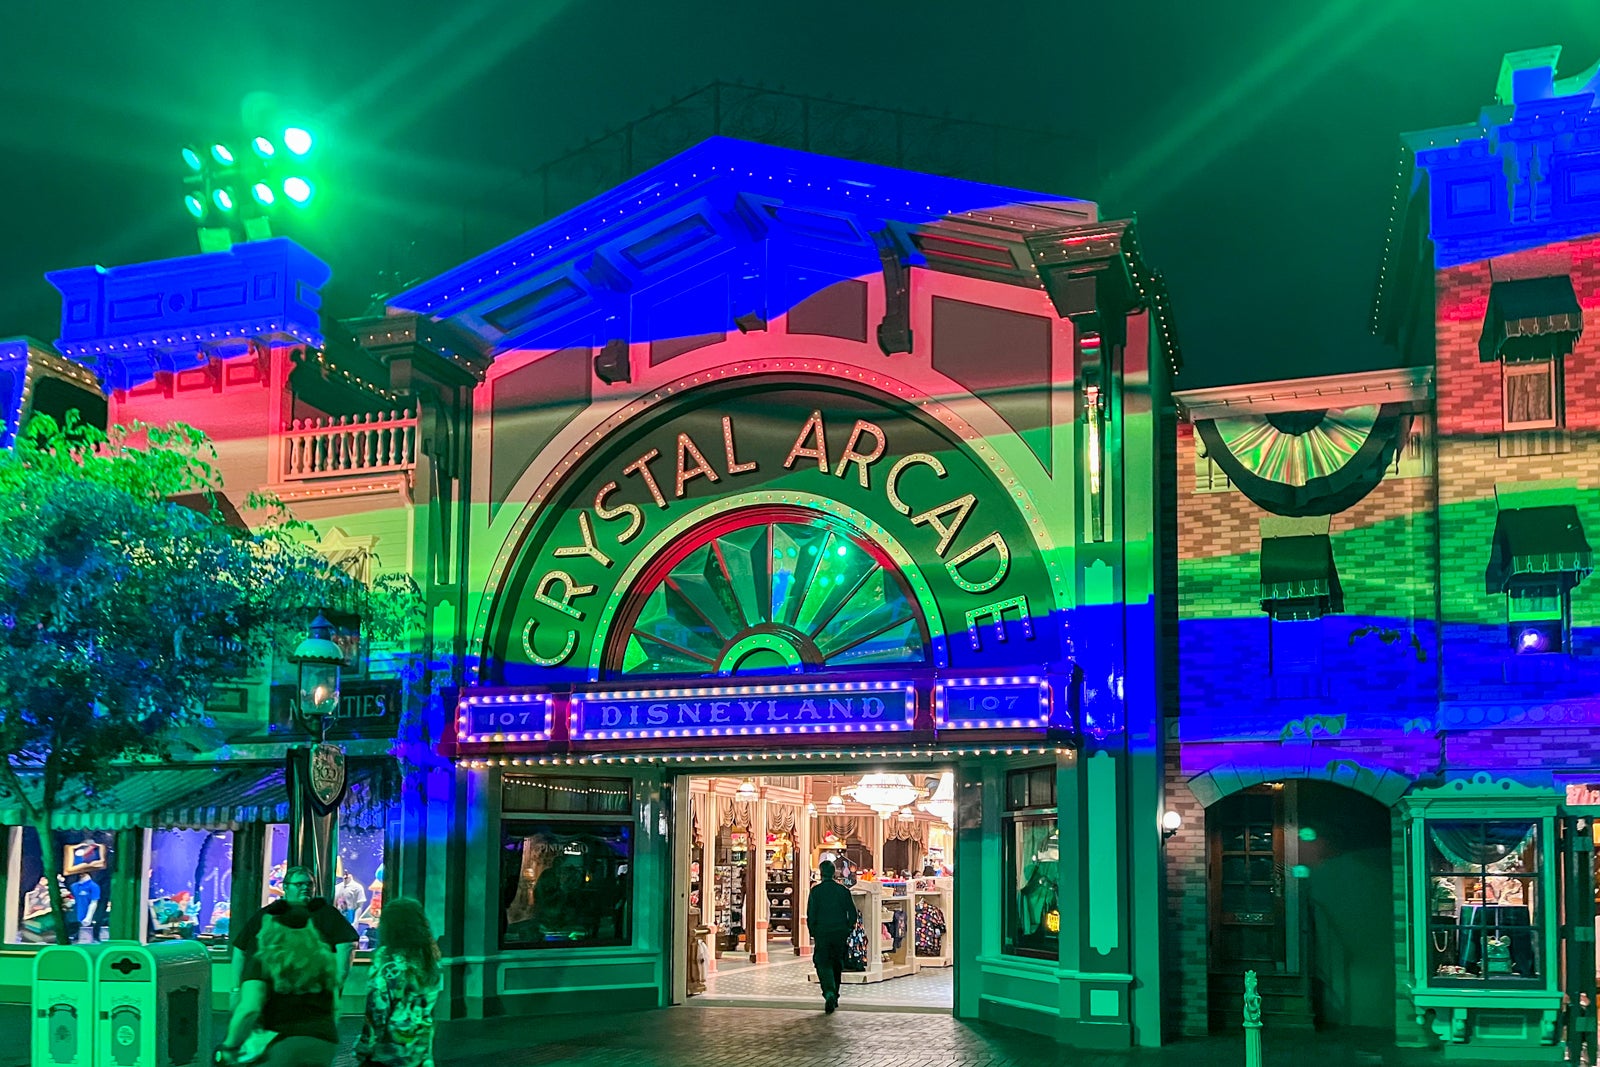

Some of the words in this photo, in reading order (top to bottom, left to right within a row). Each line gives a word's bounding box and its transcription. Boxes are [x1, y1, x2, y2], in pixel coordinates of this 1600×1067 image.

[522, 415, 757, 667] CRYSTAL
[783, 409, 1035, 651] ARCADE
[288, 694, 387, 722] NLTIES
[600, 697, 886, 727] DISNEYLAND
[968, 695, 1020, 711] 107
[488, 711, 531, 726] 107
